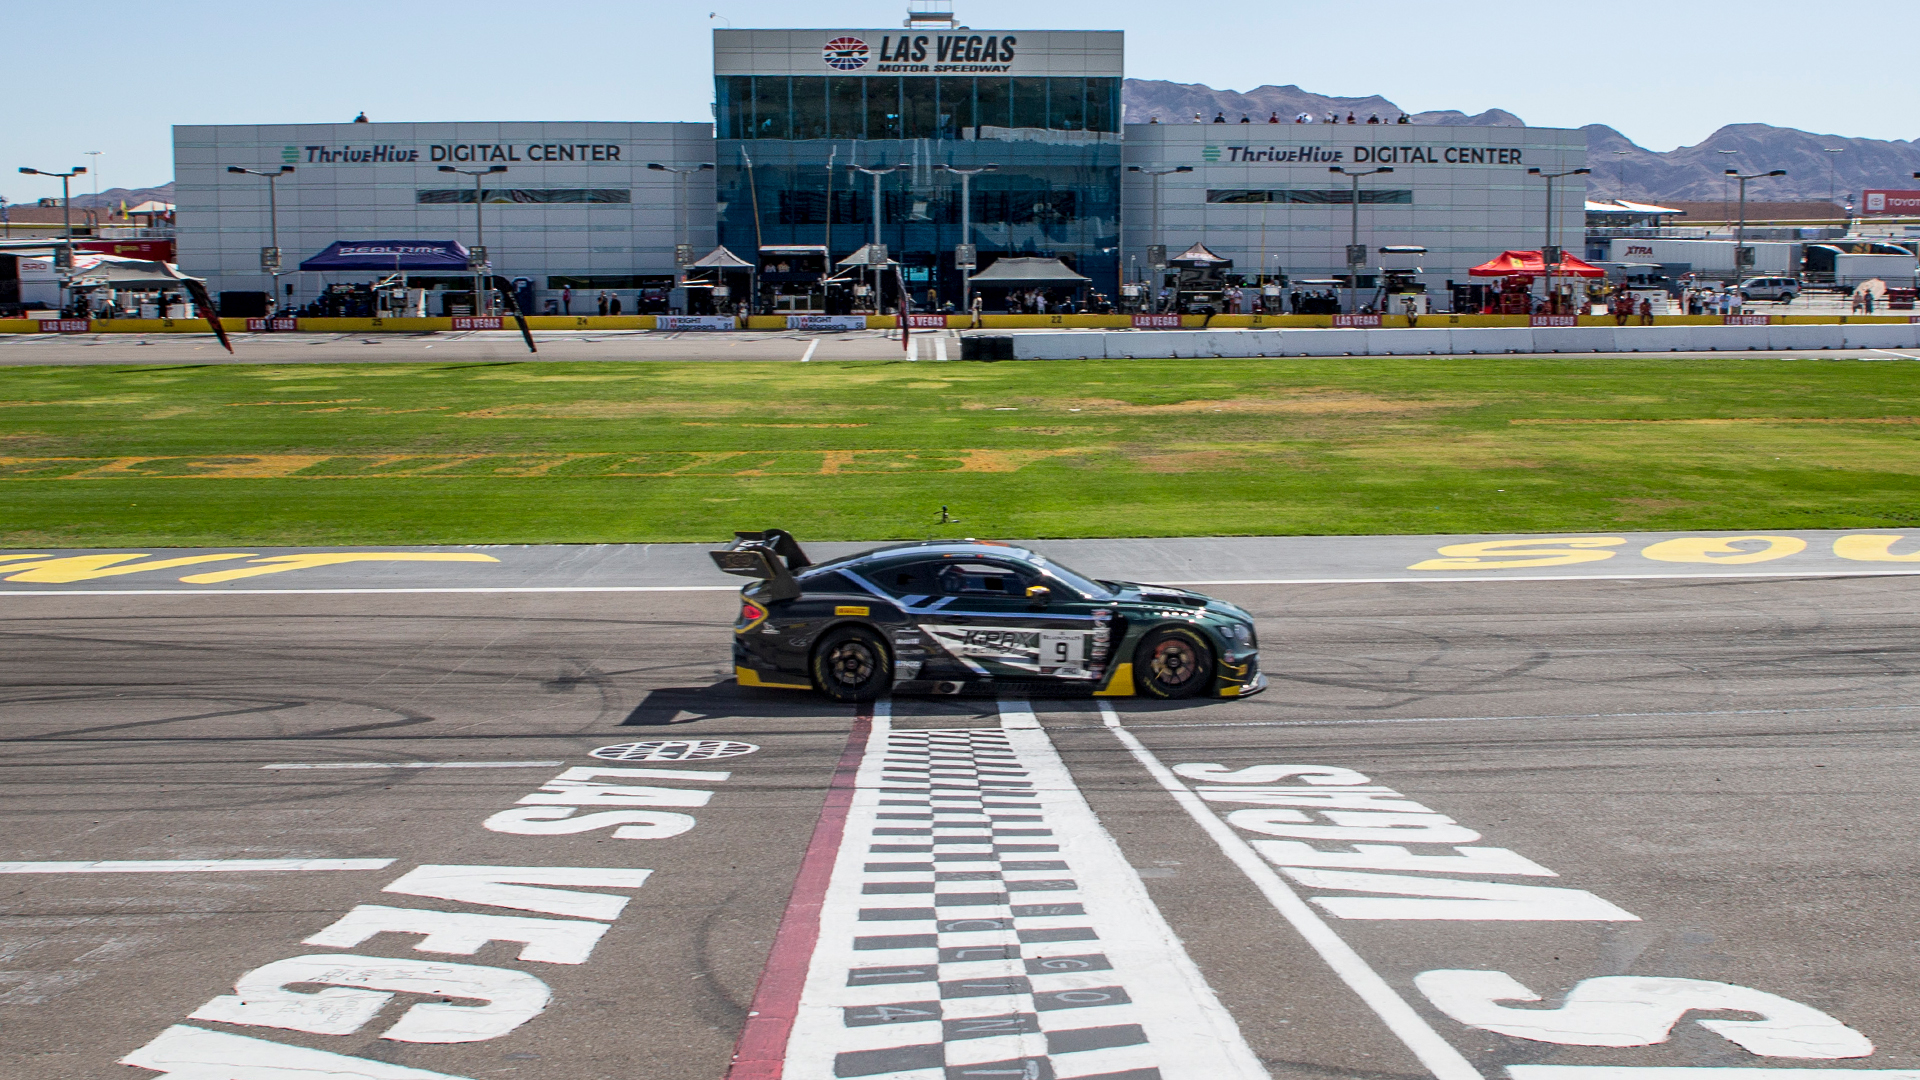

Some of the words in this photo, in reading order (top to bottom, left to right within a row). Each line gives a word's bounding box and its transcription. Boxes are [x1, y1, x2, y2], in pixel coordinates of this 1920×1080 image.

[880, 35, 929, 62] LAS
[937, 35, 1017, 62] VEGAS
[877, 64, 929, 72] MOTOR
[933, 64, 1011, 72] SPEEDWAY
[305, 145, 419, 162] ThriveHive
[430, 145, 521, 161] DIGITAL
[527, 145, 621, 161] CENTER
[1227, 146, 1344, 162] ThriveHive
[1354, 146, 1438, 163] DIGITAL
[1444, 147, 1522, 164] CENTER
[1624, 246, 1653, 256] XTRA
[22, 263, 47, 271] SRO
[42, 321, 58, 331] LAS
[60, 320, 88, 331] VEGAS
[456, 318, 471, 328] LAS
[473, 318, 500, 328] VEGAS
[917, 316, 944, 326] VEGAS
[1135, 316, 1150, 326] LAS
[1151, 316, 1178, 326] VEGAS
[1336, 316, 1351, 326] LAS
[1353, 315, 1379, 326] VEGAS
[1056, 642, 1067, 662] 9
[1172, 763, 1643, 922] VEGAS
